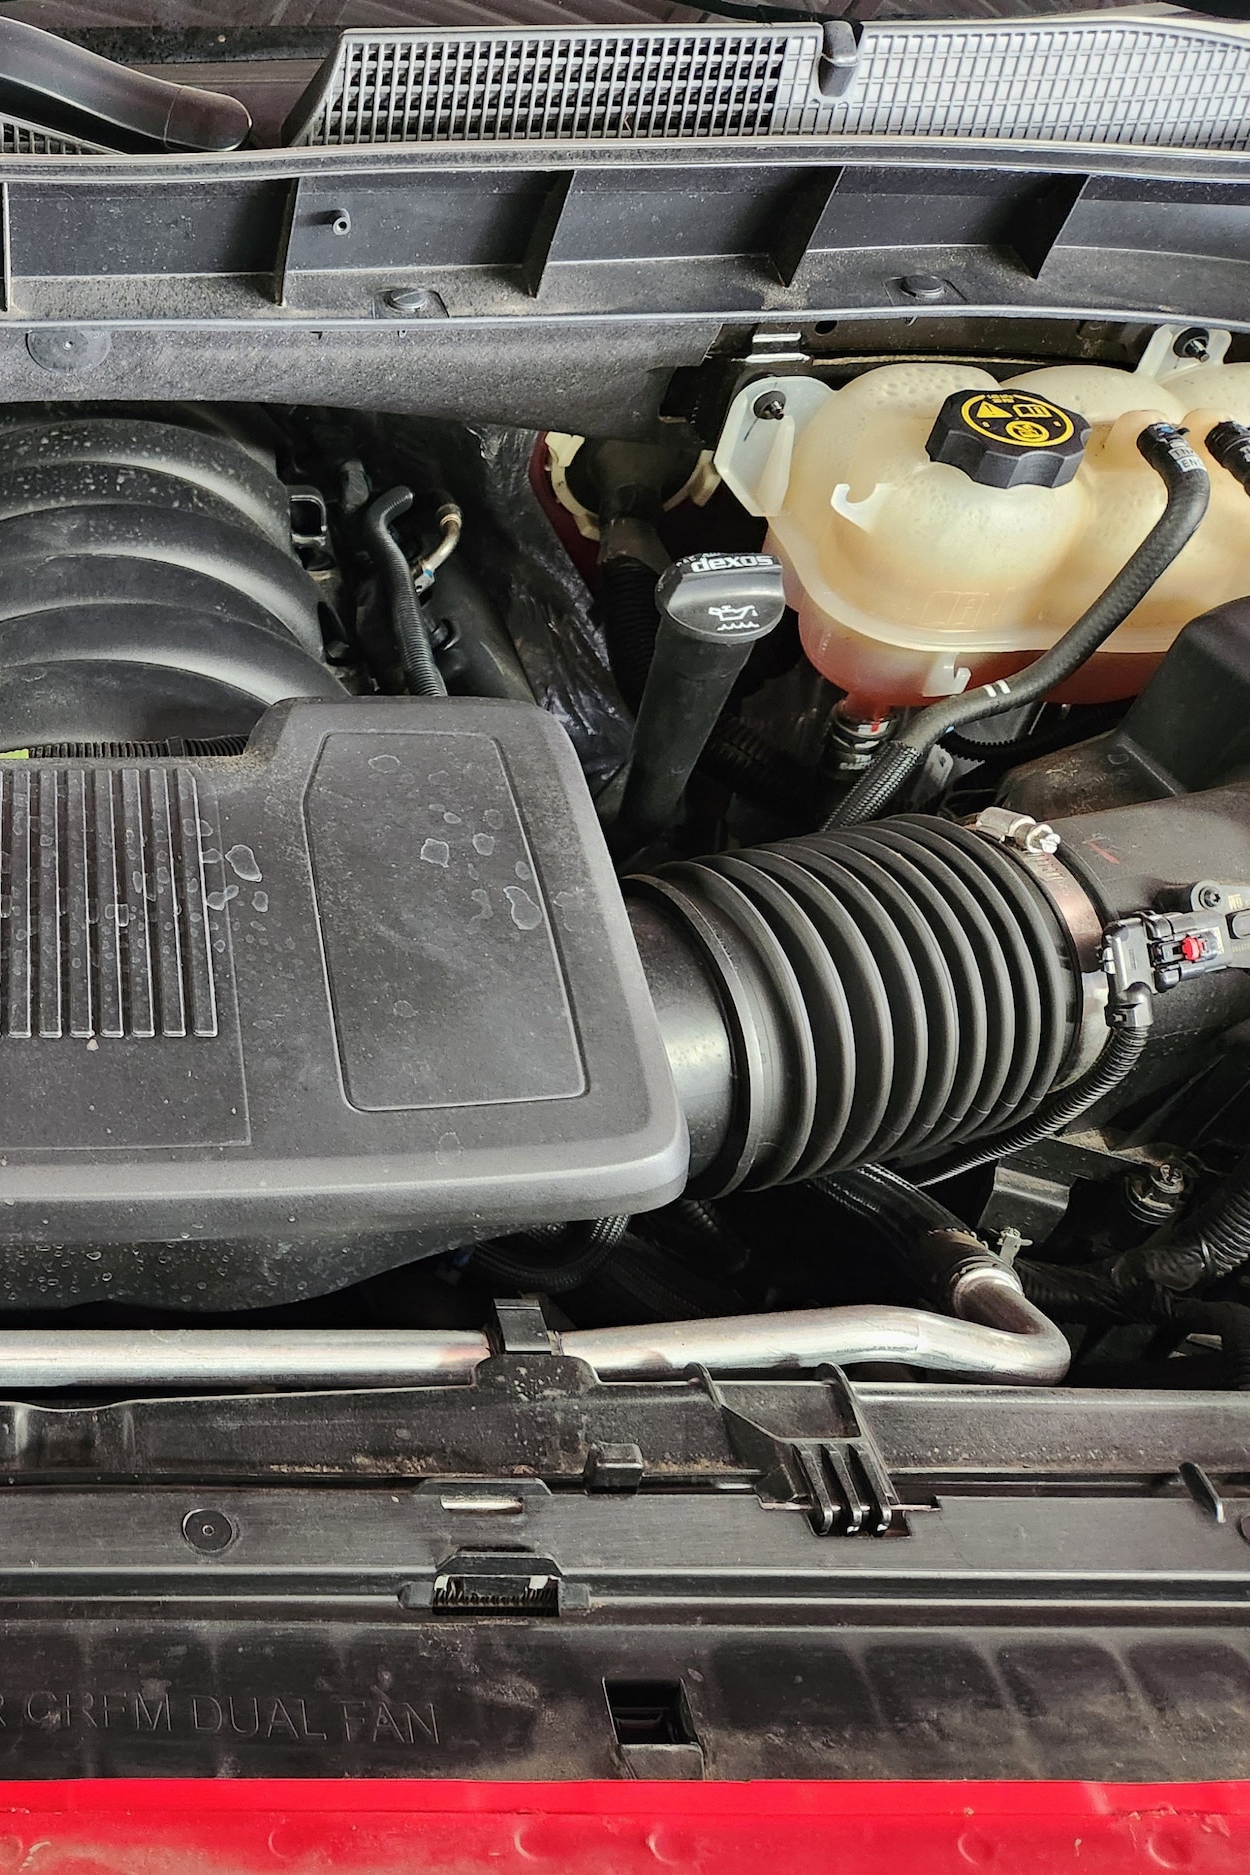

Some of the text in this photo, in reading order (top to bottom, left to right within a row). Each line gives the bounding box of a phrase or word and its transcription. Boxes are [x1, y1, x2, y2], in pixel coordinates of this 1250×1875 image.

[691, 555, 774, 572] dexos
[190, 1694, 328, 1741] DUAL
[338, 1699, 440, 1745] FAN
